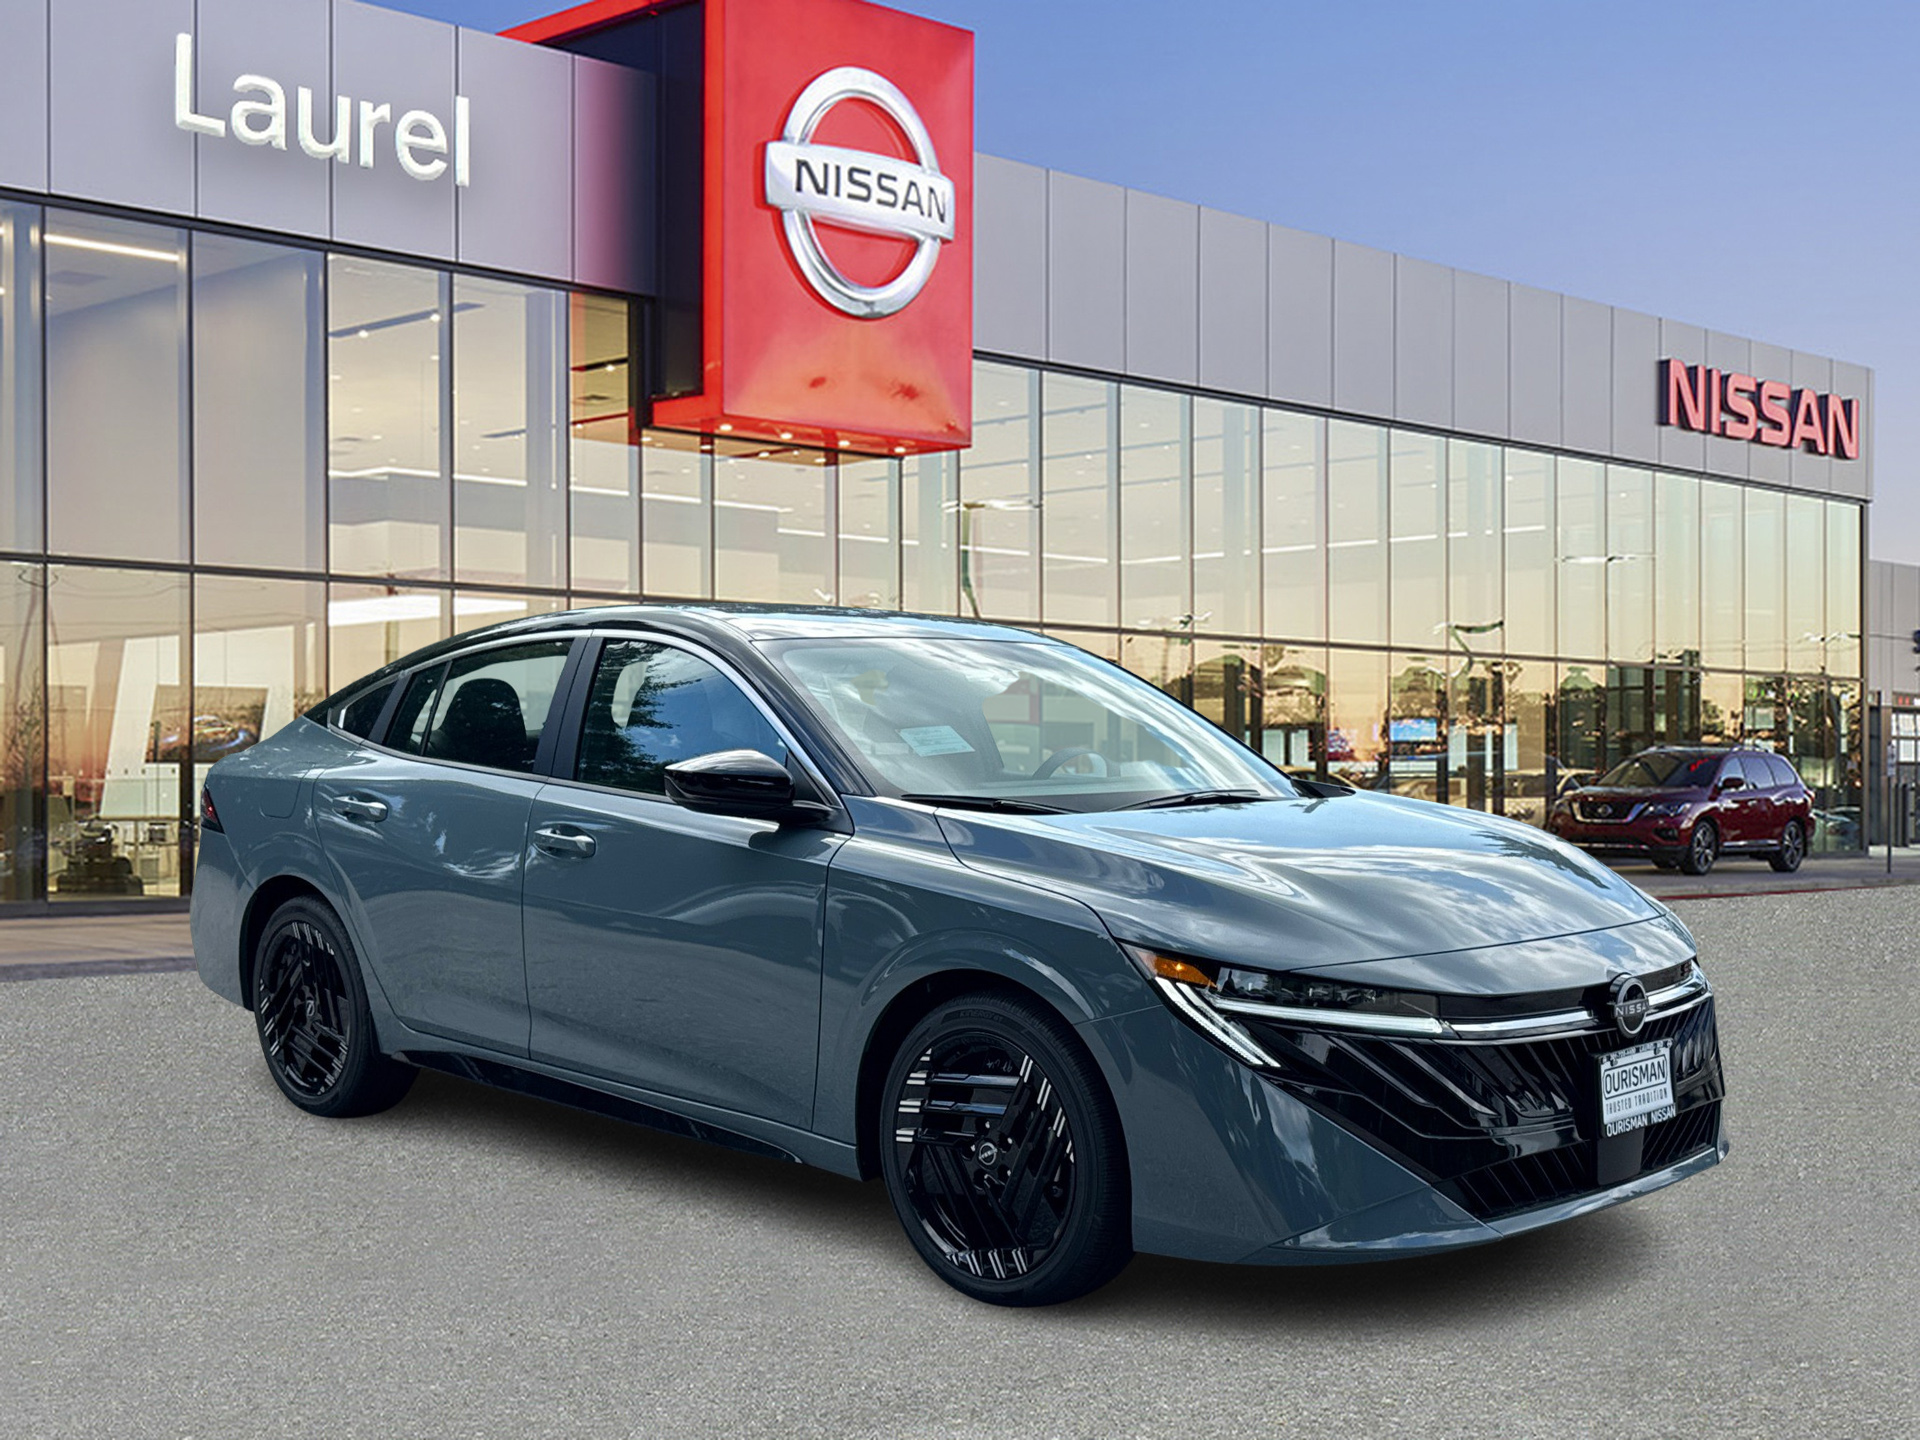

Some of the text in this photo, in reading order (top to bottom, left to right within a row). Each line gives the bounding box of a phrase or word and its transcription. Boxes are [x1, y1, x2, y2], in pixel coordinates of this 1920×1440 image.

[174, 32, 470, 188] Laurel
[795, 158, 946, 224] NISSAN
[1660, 358, 1860, 460] NISSAN
[1604, 1059, 1666, 1095] OURISMAN
[1606, 1087, 1668, 1115] TRUSTED TRADITION
[1606, 1104, 1676, 1138] OURISMAN NISSAN
